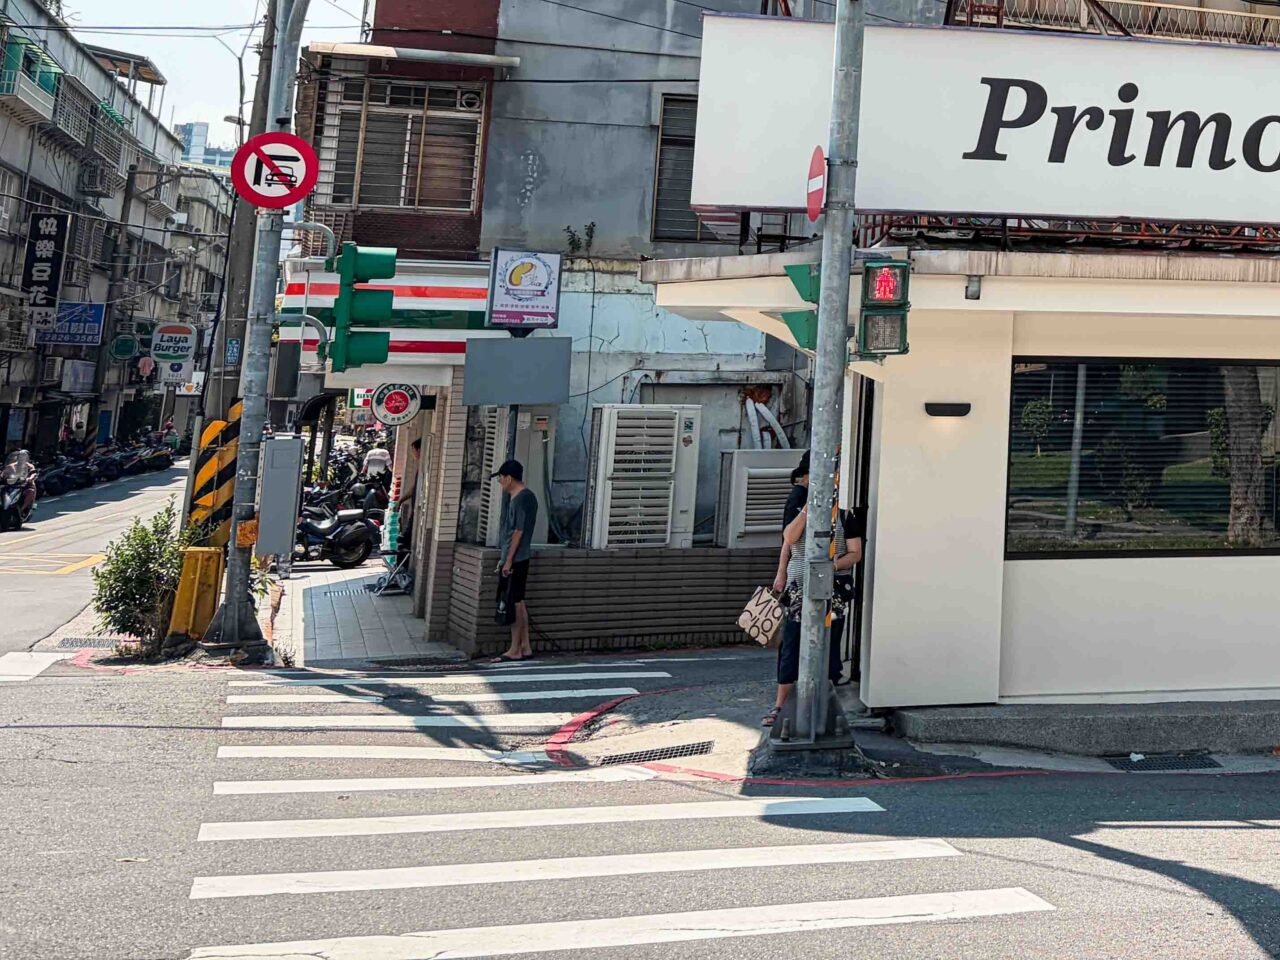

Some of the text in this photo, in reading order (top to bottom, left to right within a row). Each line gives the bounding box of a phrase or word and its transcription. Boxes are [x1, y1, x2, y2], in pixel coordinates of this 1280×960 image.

[29, 216, 58, 305] 快樂豆花
[159, 334, 189, 345] Laya
[153, 343, 192, 354] Burger
